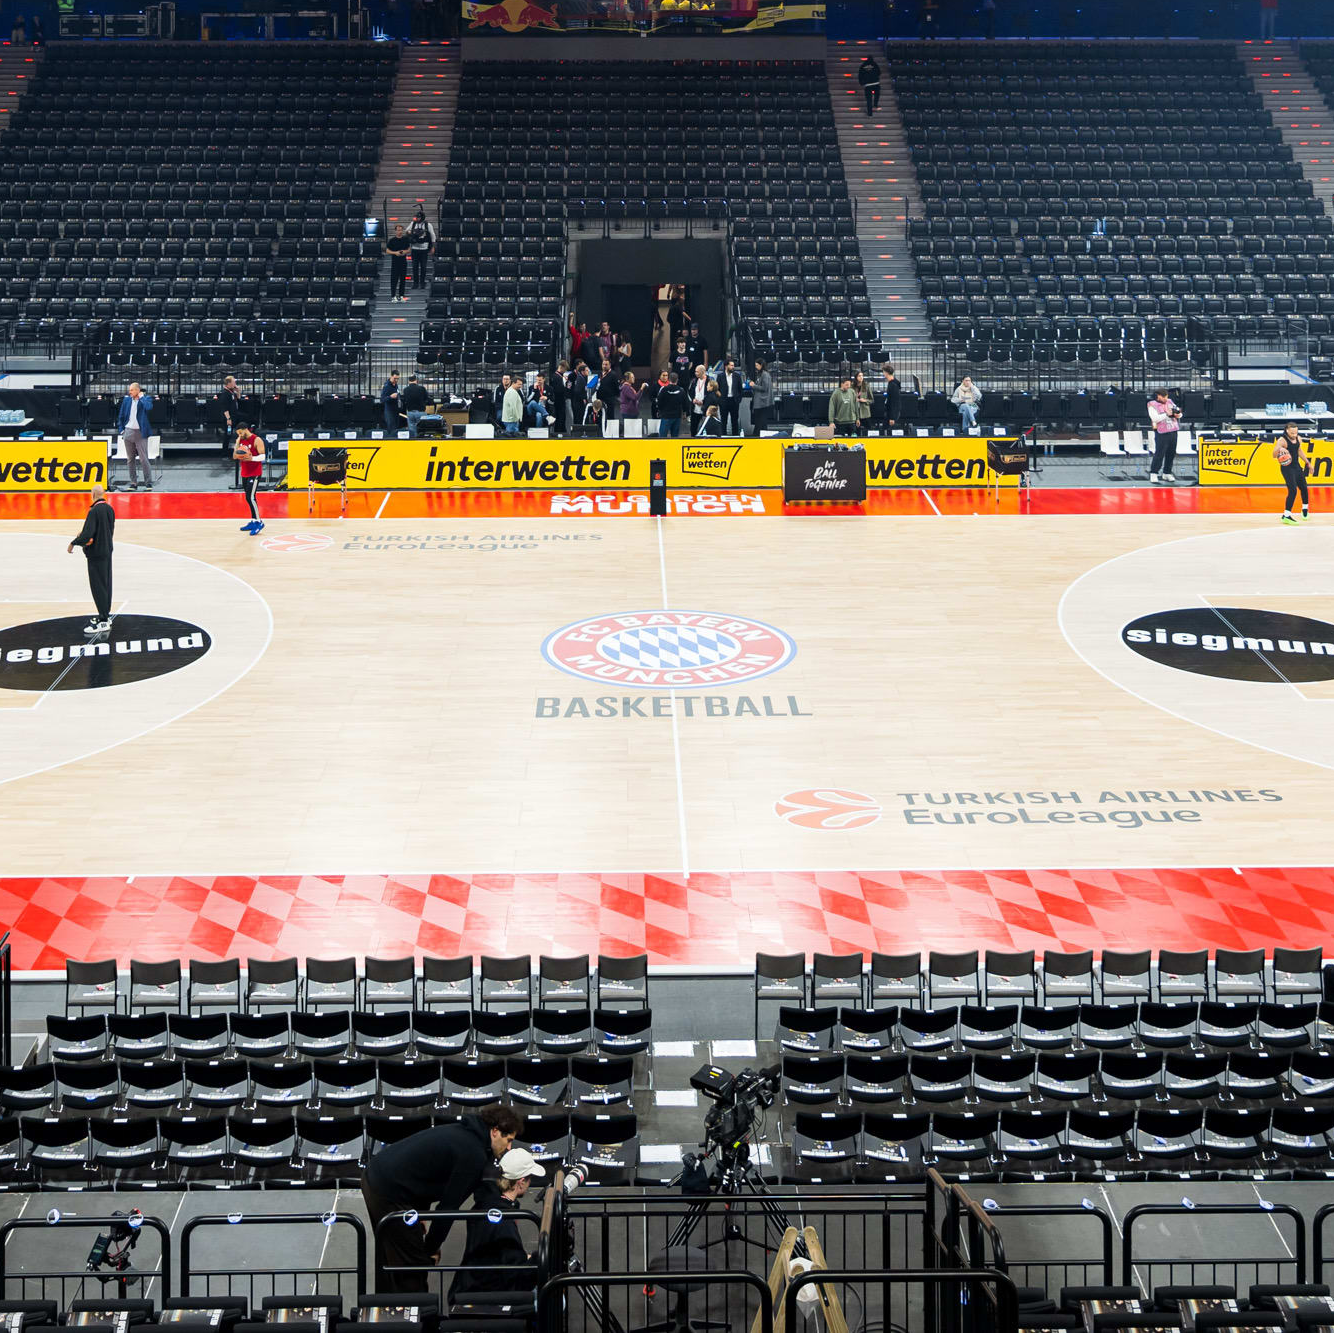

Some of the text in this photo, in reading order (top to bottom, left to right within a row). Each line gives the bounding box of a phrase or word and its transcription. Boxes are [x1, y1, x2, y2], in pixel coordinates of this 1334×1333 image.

[685, 449, 714, 460] inter
[1204, 447, 1232, 458] inter
[425, 446, 631, 482] interwetten
[687, 458, 728, 470] wetten
[1207, 455, 1247, 467] wetten
[813, 467, 838, 480] BALL
[551, 495, 616, 503] SAP
[351, 533, 602, 542] TURKISH AIRLINES
[343, 541, 538, 553] EuroLeague
[565, 613, 774, 644] FC BAYERN
[535, 695, 814, 719] BASKETBALL
[897, 788, 1284, 806] TURKISH AIRLINES
[903, 806, 1204, 829] EuroLeague
